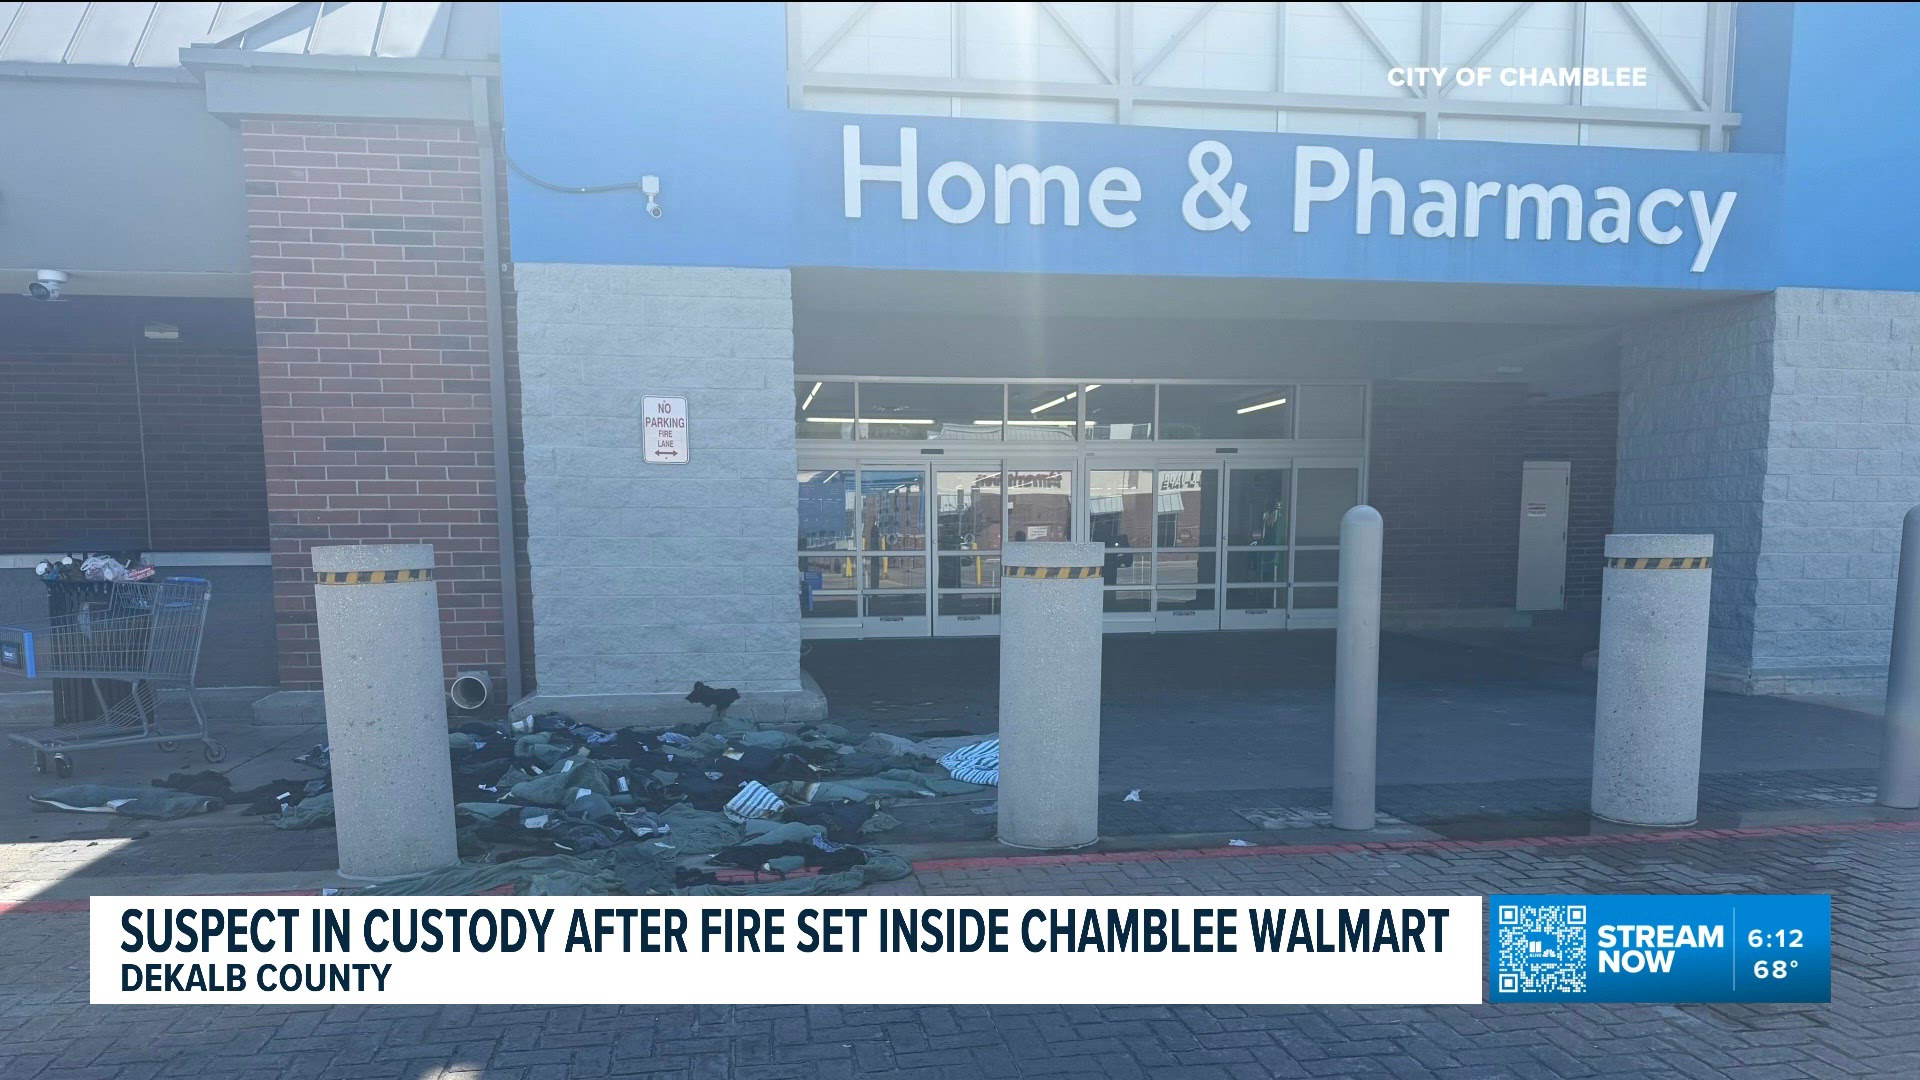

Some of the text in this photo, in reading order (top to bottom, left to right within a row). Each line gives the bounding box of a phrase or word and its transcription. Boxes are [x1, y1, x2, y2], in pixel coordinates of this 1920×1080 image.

[843, 125, 1737, 272] Home & Pharmacy
[658, 403, 671, 413] NO
[645, 417, 685, 428] PARKING
